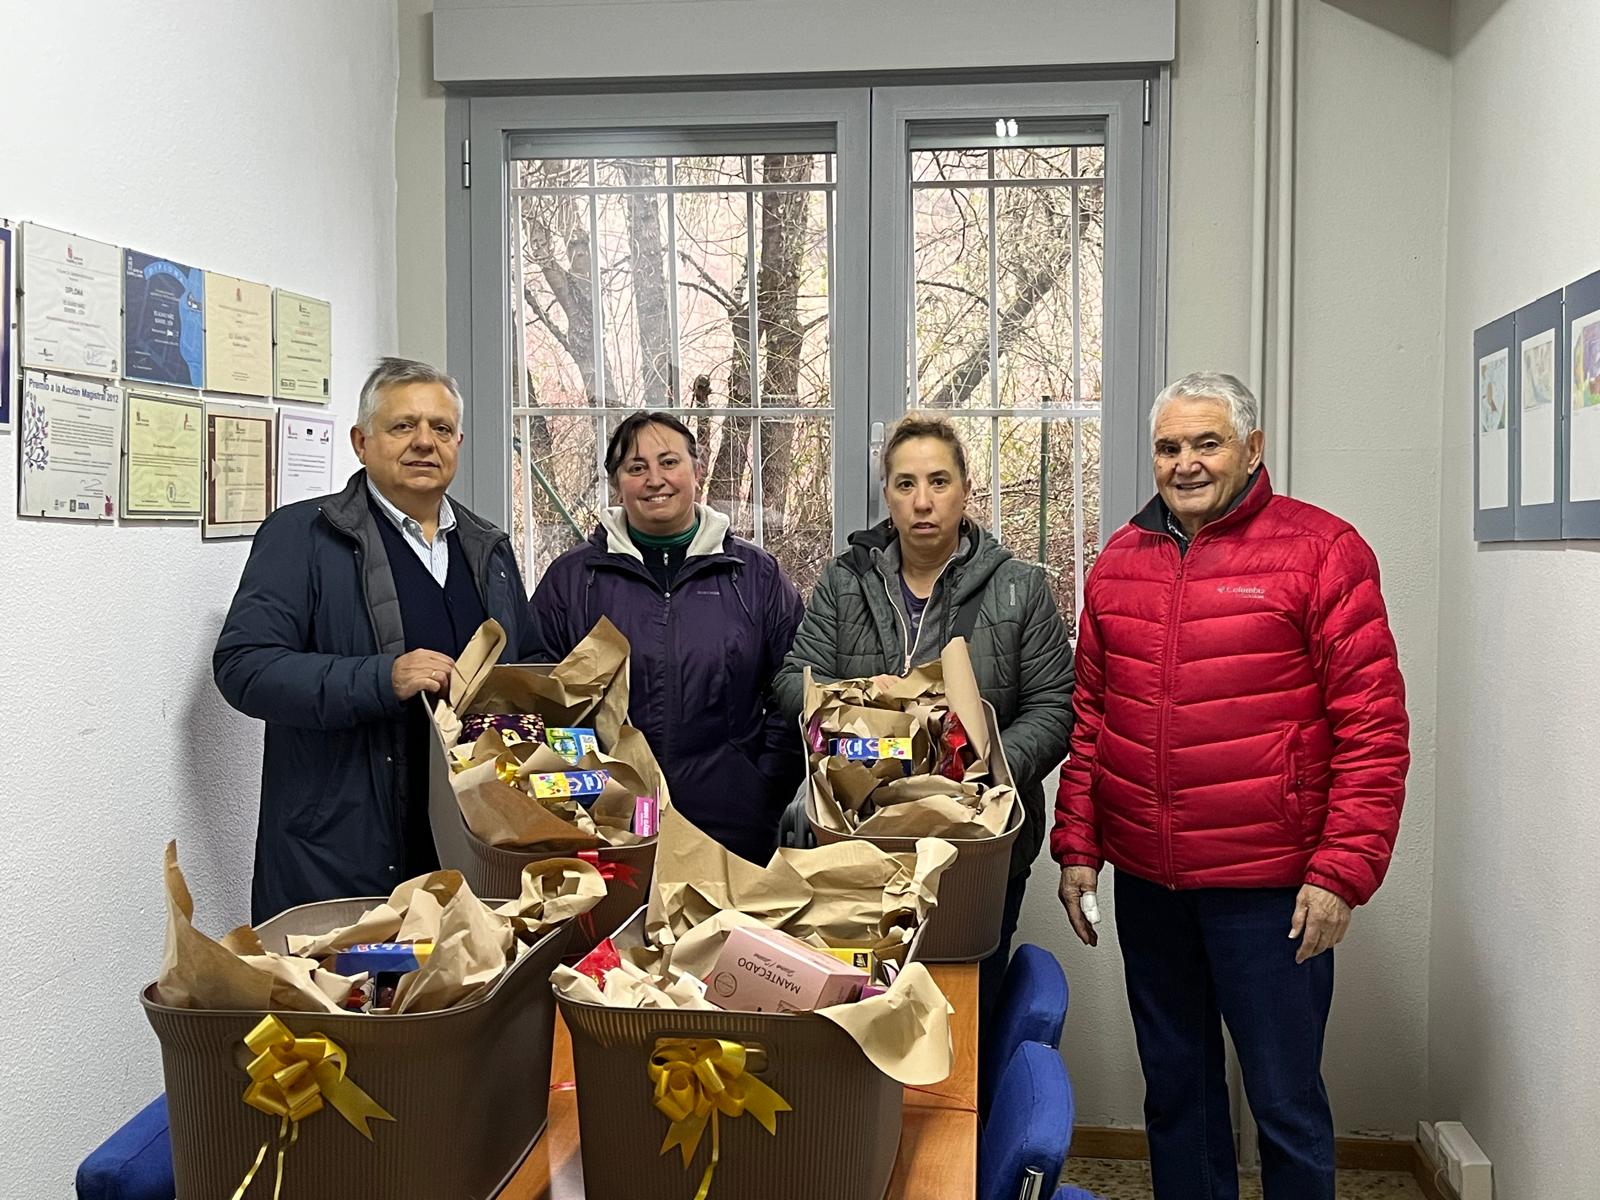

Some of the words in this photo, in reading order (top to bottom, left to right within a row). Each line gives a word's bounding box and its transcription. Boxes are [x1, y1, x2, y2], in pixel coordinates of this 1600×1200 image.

[28, 378, 49, 391] Premio
[56, 383, 61, 393] la
[82, 389, 106, 400] Magistral
[106, 393, 119, 403] 2012
[737, 956, 802, 994] MANTECADO
